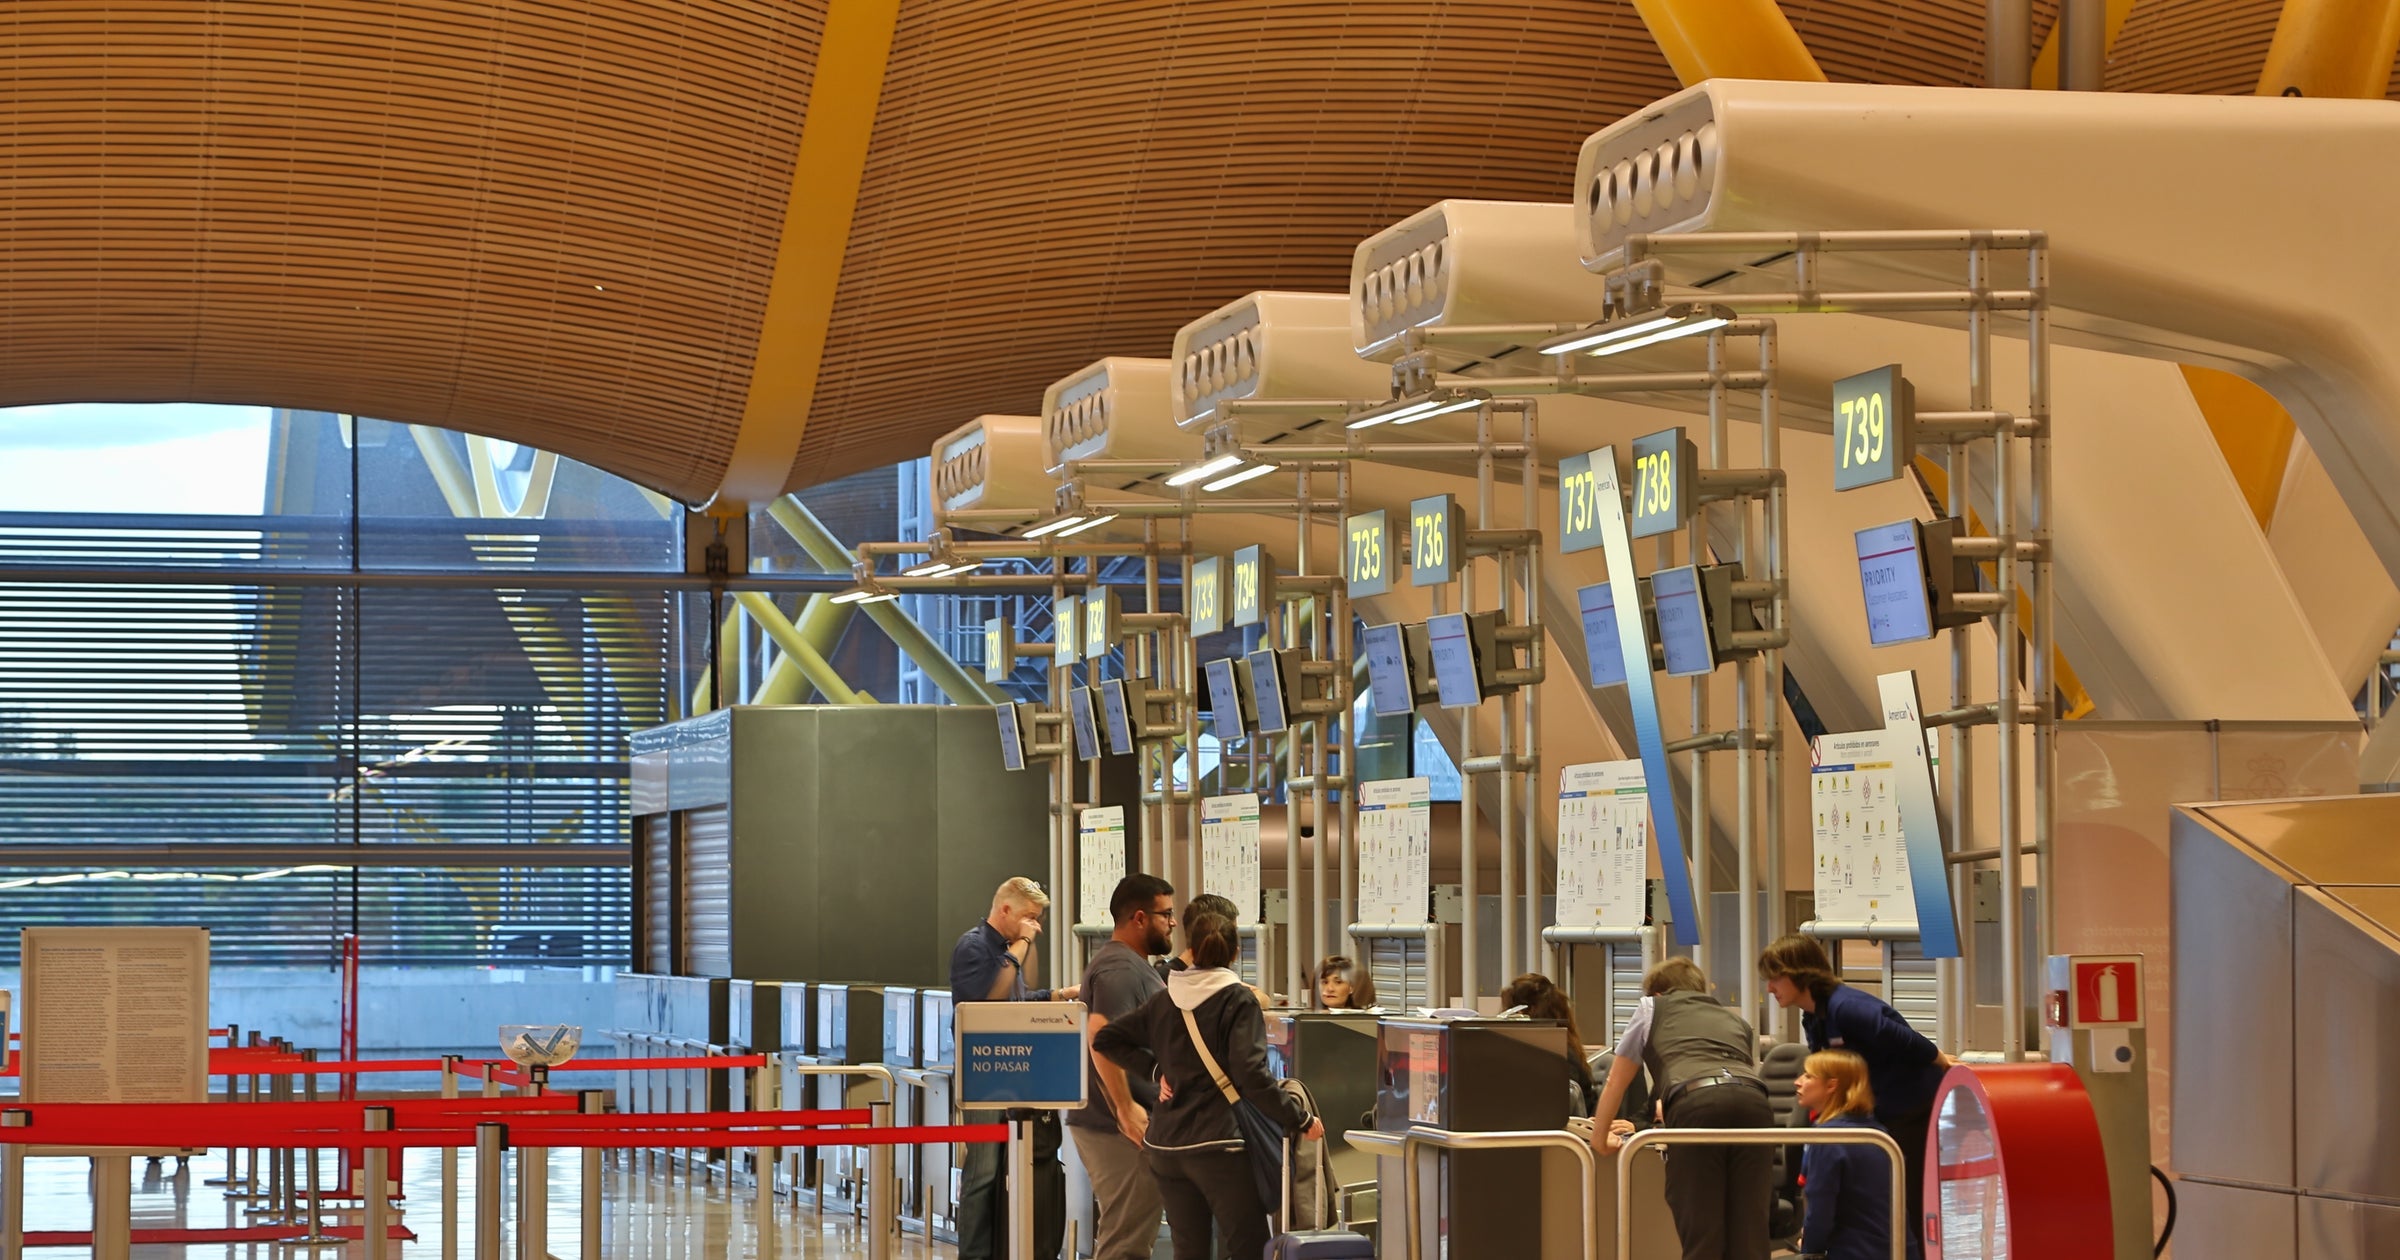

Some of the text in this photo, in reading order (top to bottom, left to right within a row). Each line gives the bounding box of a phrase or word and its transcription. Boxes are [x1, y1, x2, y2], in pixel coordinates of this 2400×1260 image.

[1840, 392, 1884, 469] 739
[1564, 470, 1595, 535] 737
[1637, 449, 1671, 518] 738
[1352, 527, 1381, 583] 735
[1415, 512, 1444, 570] 736
[1194, 573, 1214, 623] 733
[1236, 560, 1256, 612] 734
[1864, 567, 1896, 587] PRIORITY
[1057, 610, 1071, 654] 731
[1089, 599, 1104, 645] 732
[987, 630, 1000, 671] 730
[1888, 709, 1907, 721] American
[1030, 1016, 1063, 1024] American
[972, 1045, 1033, 1056] NO ENTRY
[972, 1061, 1030, 1072] NO PASAR
